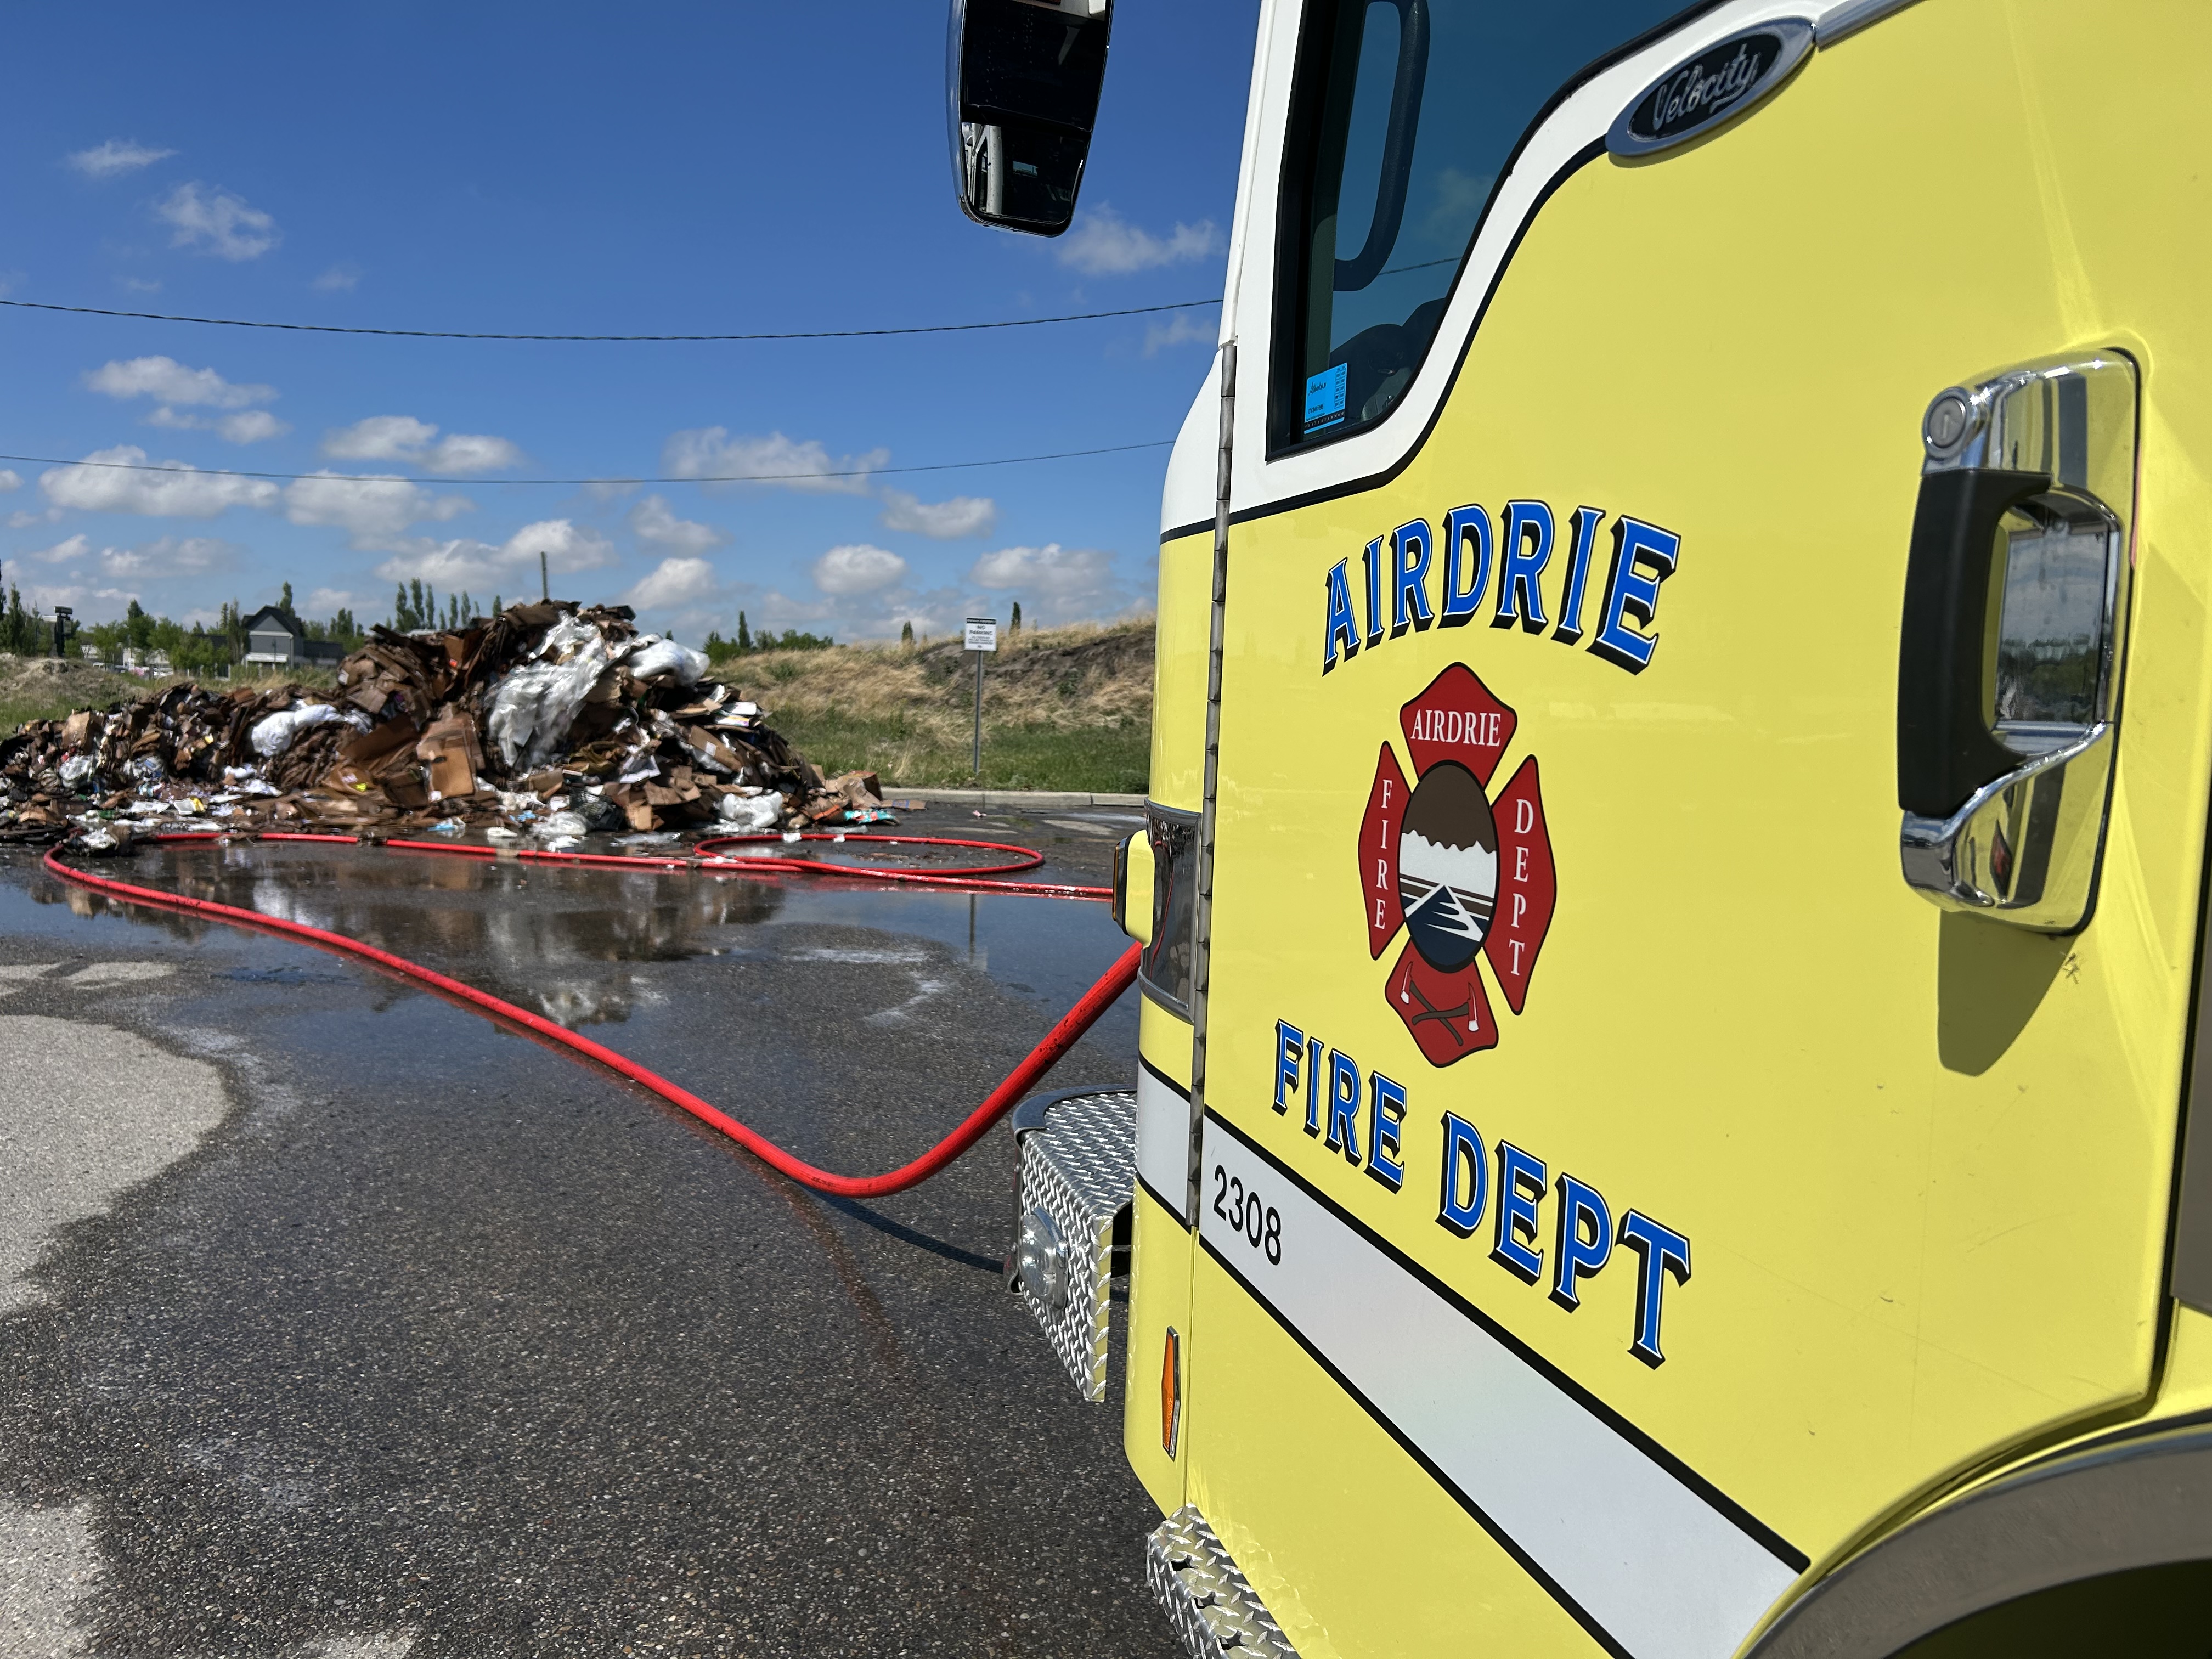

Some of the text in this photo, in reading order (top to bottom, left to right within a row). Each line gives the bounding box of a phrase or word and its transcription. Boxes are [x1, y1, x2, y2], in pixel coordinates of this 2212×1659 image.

[1652, 43, 1762, 131] Velocity
[1322, 499, 1681, 675] AIRDRIE
[1410, 709, 1502, 747] AIRDRIE
[1374, 779, 1392, 930] FIRE
[1509, 798, 1534, 976] DEPT
[1214, 1165, 1282, 1266] 2308
[1272, 1019, 1691, 1370] FIRE DEPT
